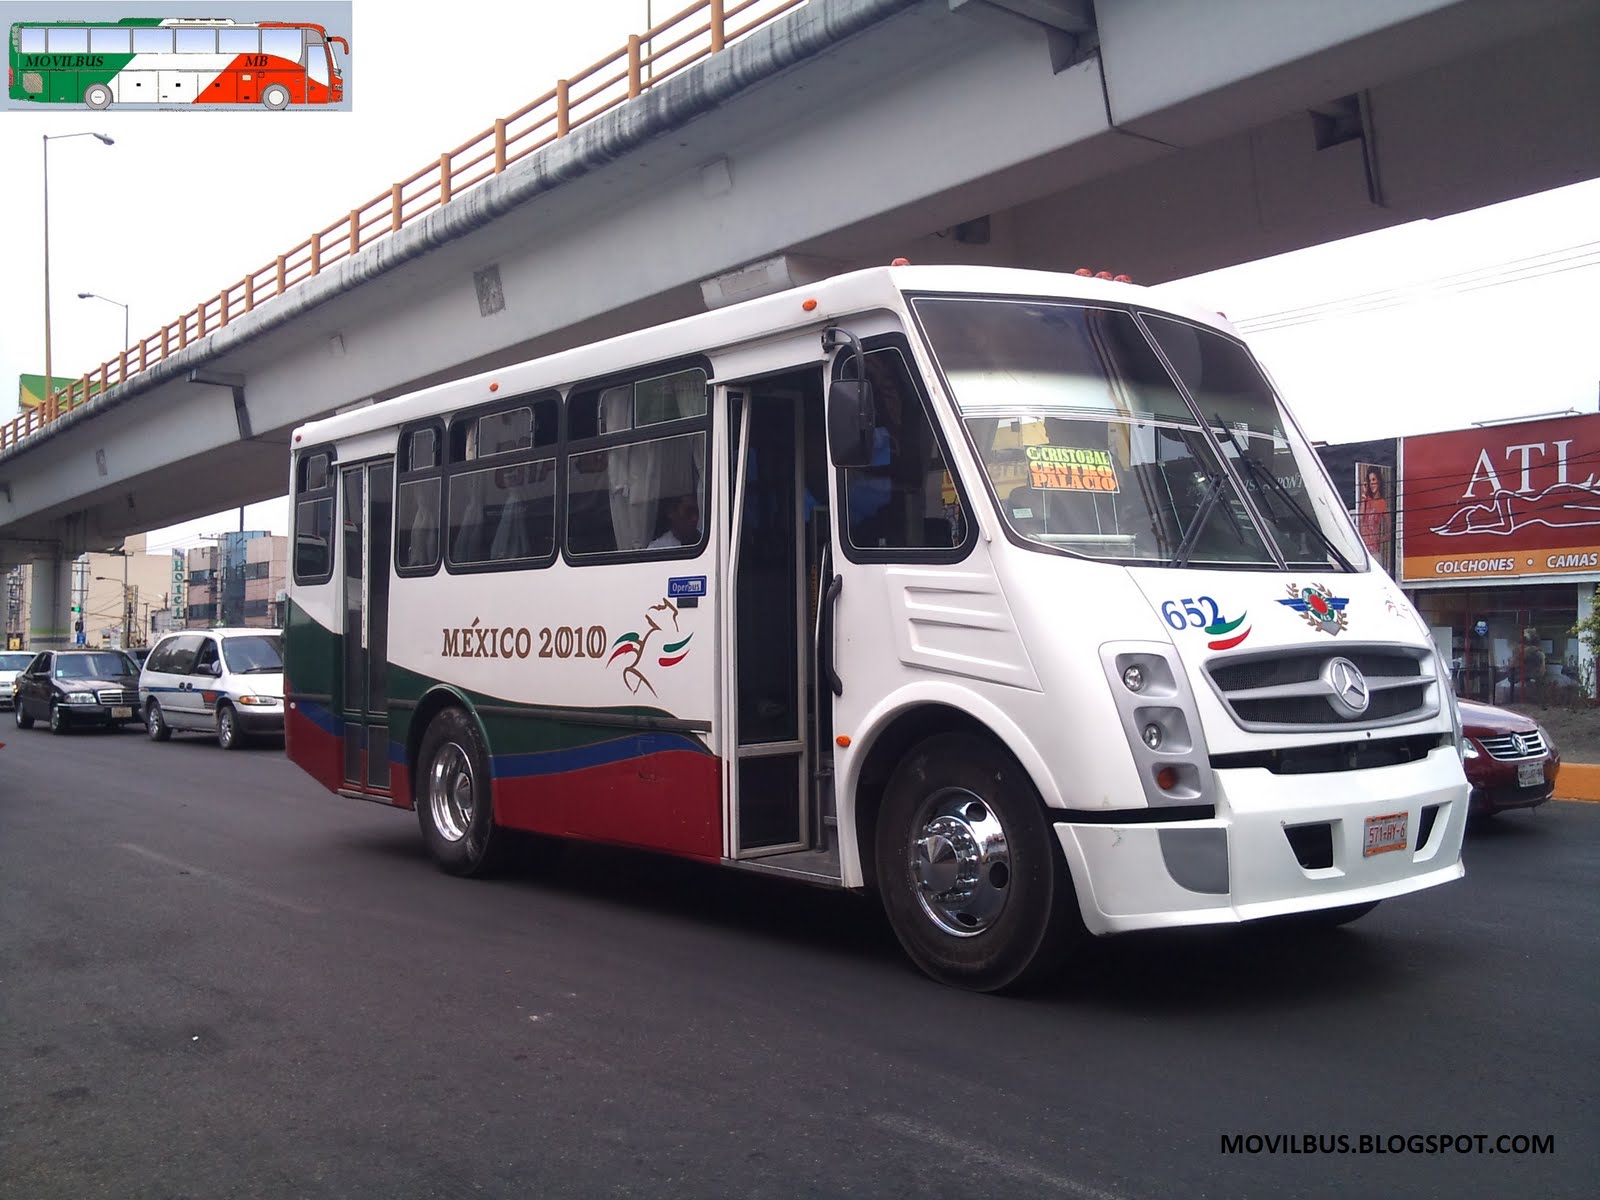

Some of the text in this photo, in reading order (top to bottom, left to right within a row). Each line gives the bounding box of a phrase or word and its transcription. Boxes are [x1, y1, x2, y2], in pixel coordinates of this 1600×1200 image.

[1041, 447, 1110, 465] CRISTOBAL
[1029, 460, 1113, 478] CENTRO
[1462, 439, 1600, 498] ATL
[1031, 472, 1116, 491] PALACIO
[1435, 553, 1598, 574] COLCHONES CAMAS
[173, 560, 184, 619] Hotel
[672, 582, 700, 594] Operbus
[1161, 595, 1226, 631] 652
[441, 616, 607, 659] MÉXICO 2010
